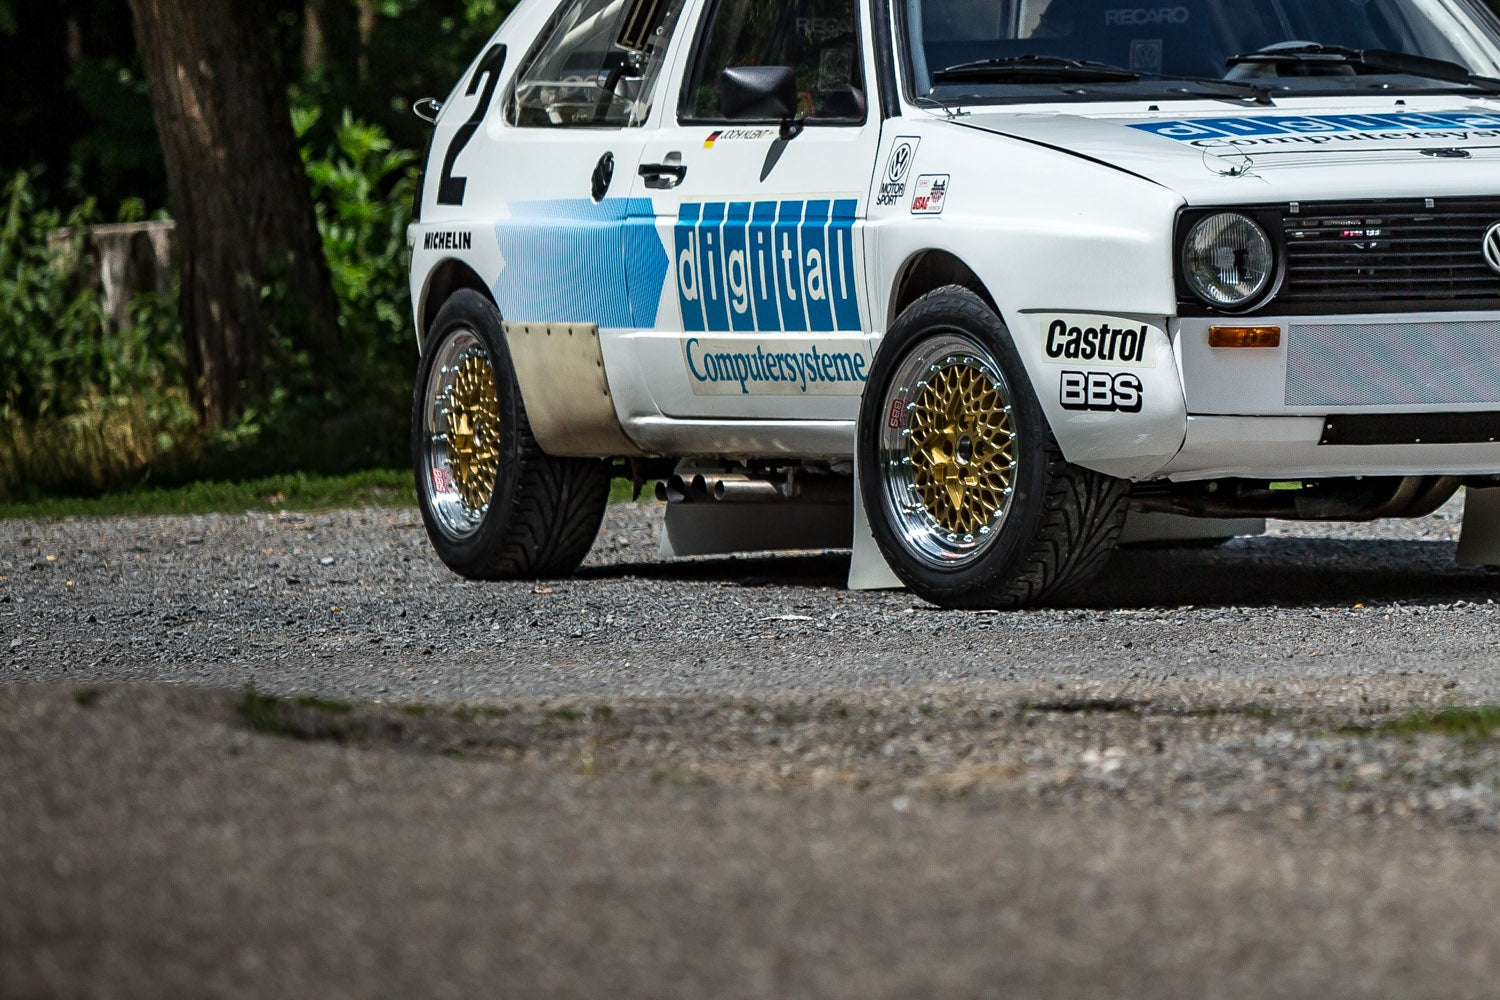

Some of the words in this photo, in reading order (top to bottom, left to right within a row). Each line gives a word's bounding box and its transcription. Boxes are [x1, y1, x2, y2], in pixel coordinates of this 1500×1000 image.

[1104, 6, 1190, 26] RECARO
[437, 43, 507, 206] 2
[876, 194, 898, 206] SPORT
[881, 182, 905, 195] MOTOR
[423, 231, 472, 250] MICHELIN
[678, 229, 848, 314] digital
[1045, 319, 1149, 362] Castrol
[685, 337, 869, 394] Computersysteme
[1060, 370, 1143, 413] BBS
[888, 399, 904, 428] BBS
